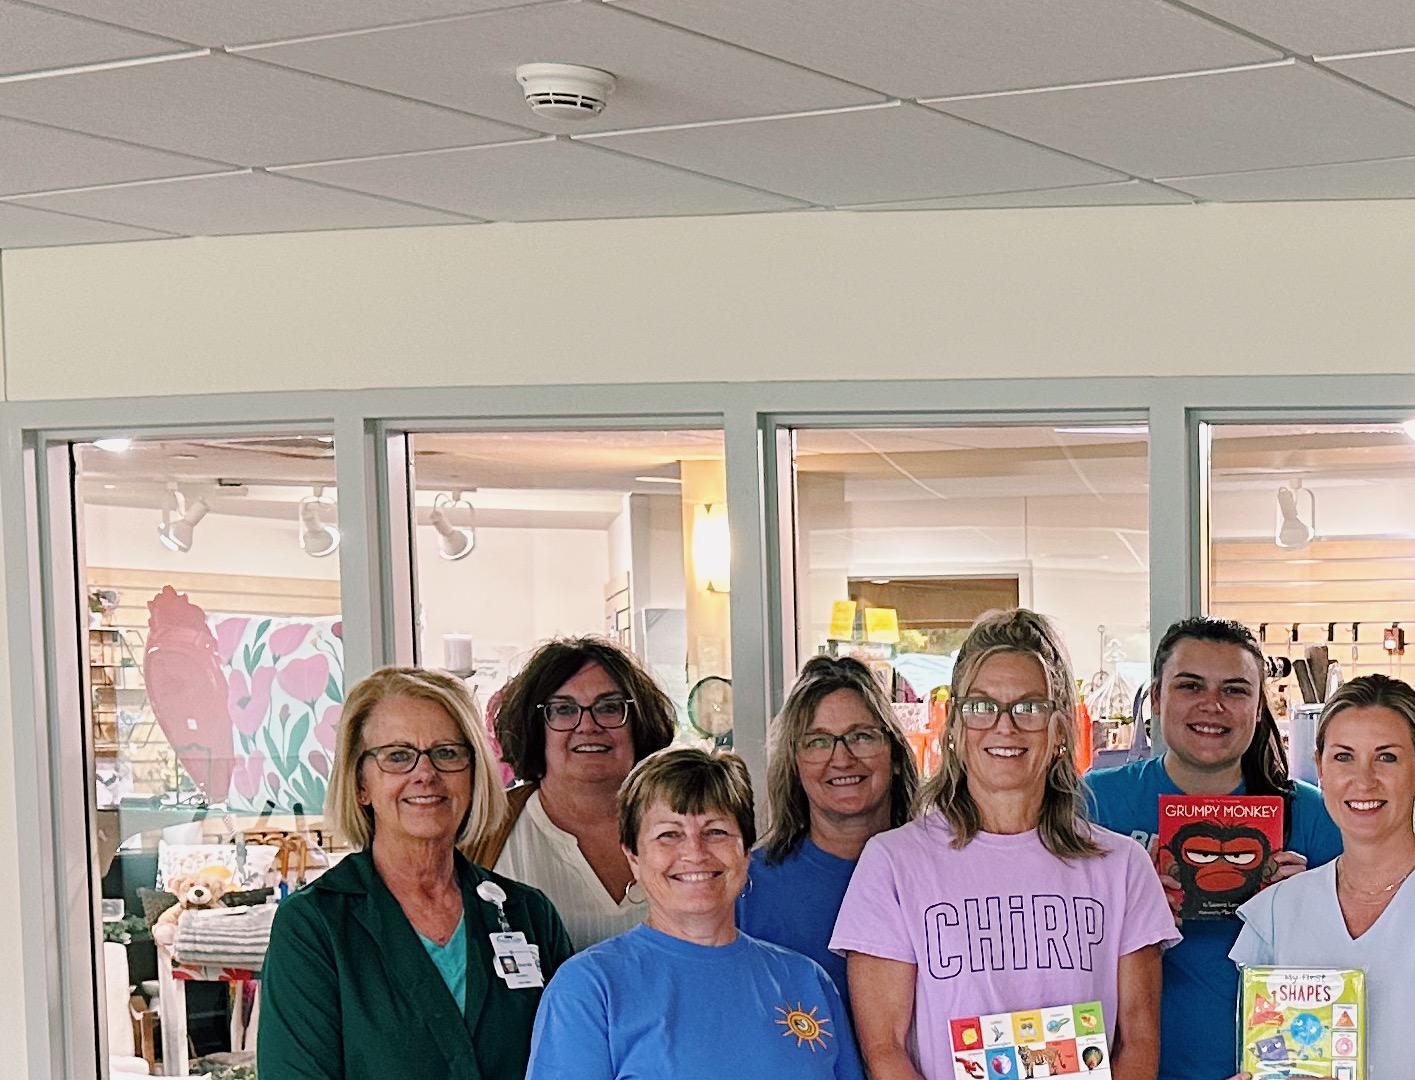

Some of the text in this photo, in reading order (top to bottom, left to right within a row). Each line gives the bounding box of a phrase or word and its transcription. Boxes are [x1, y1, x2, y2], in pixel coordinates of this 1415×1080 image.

[1165, 804, 1278, 818] GRUMPY MONKEY
[1279, 984, 1332, 1002] SHAPES
